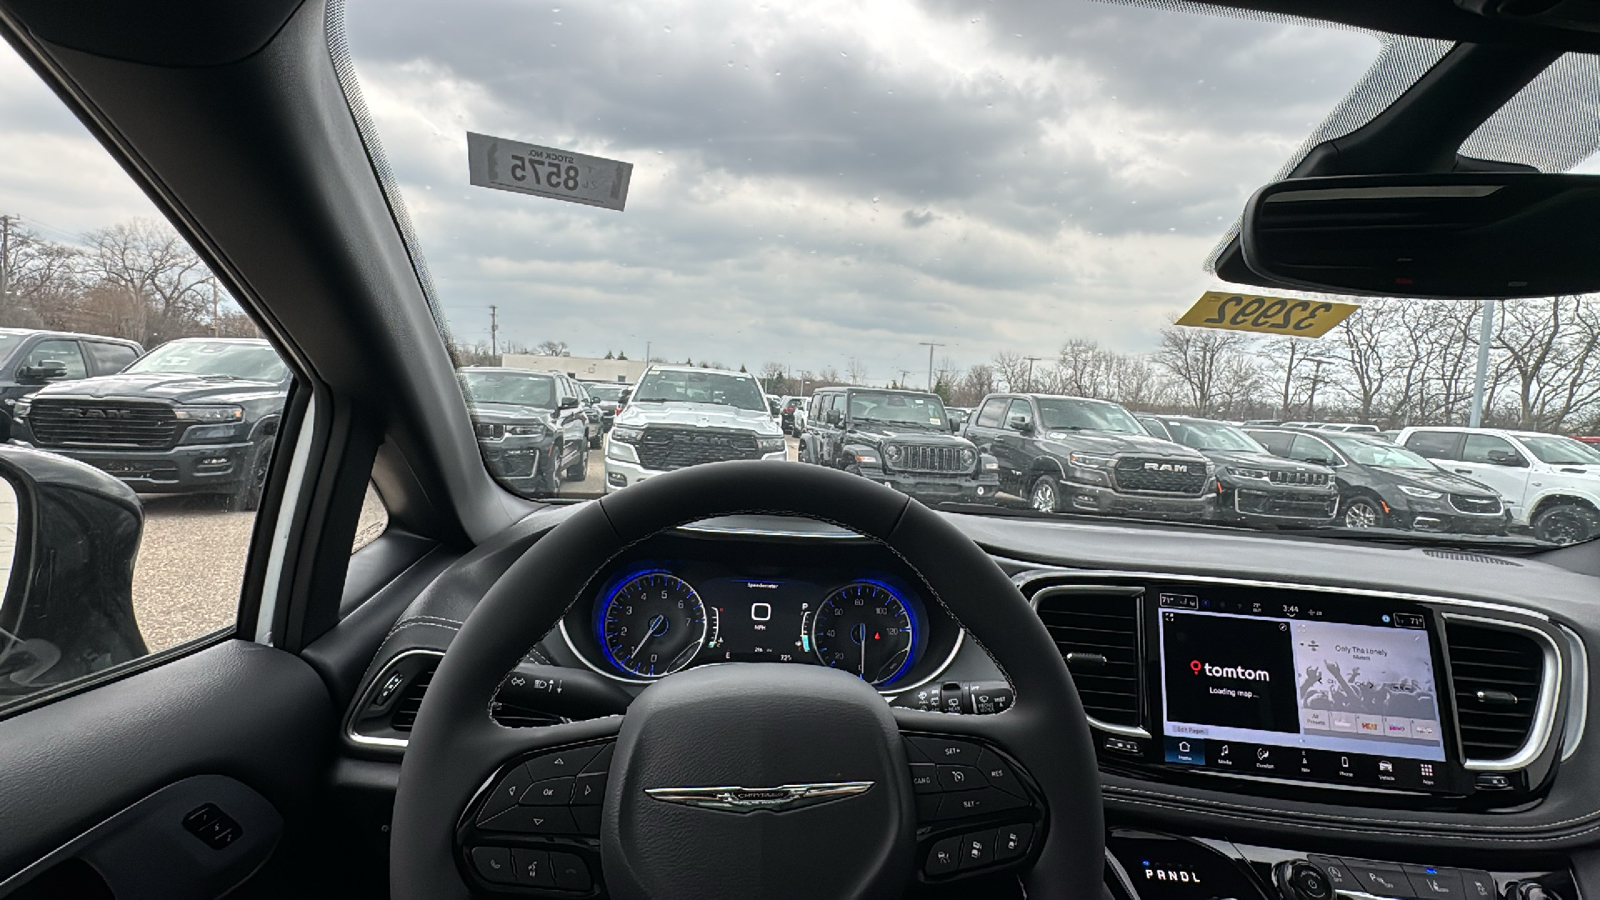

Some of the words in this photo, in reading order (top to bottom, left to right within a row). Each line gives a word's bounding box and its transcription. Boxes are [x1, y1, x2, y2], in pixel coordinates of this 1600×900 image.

[61, 407, 131, 418] RAM
[1144, 462, 1188, 473] RAM
[640, 592, 647, 601] 4
[661, 590, 668, 599] 5
[677, 600, 684, 609] 6
[802, 602, 809, 610] P
[1282, 604, 1299, 613] 3:44
[626, 606, 633, 615] 3
[751, 602, 772, 621] 0
[685, 617, 692, 627] 7
[620, 626, 627, 636] 2
[826, 629, 835, 638] 40
[886, 627, 898, 636] 120
[1335, 644, 1351, 654] Only
[1352, 646, 1365, 654] The
[1366, 647, 1388, 657] Lonely
[650, 654, 658, 663] 0
[834, 652, 844, 660] 20
[1204, 662, 1270, 682] tomtom
[1209, 686, 1236, 698] Loading
[991, 769, 1003, 777] RES
[543, 788, 554, 796] OK
